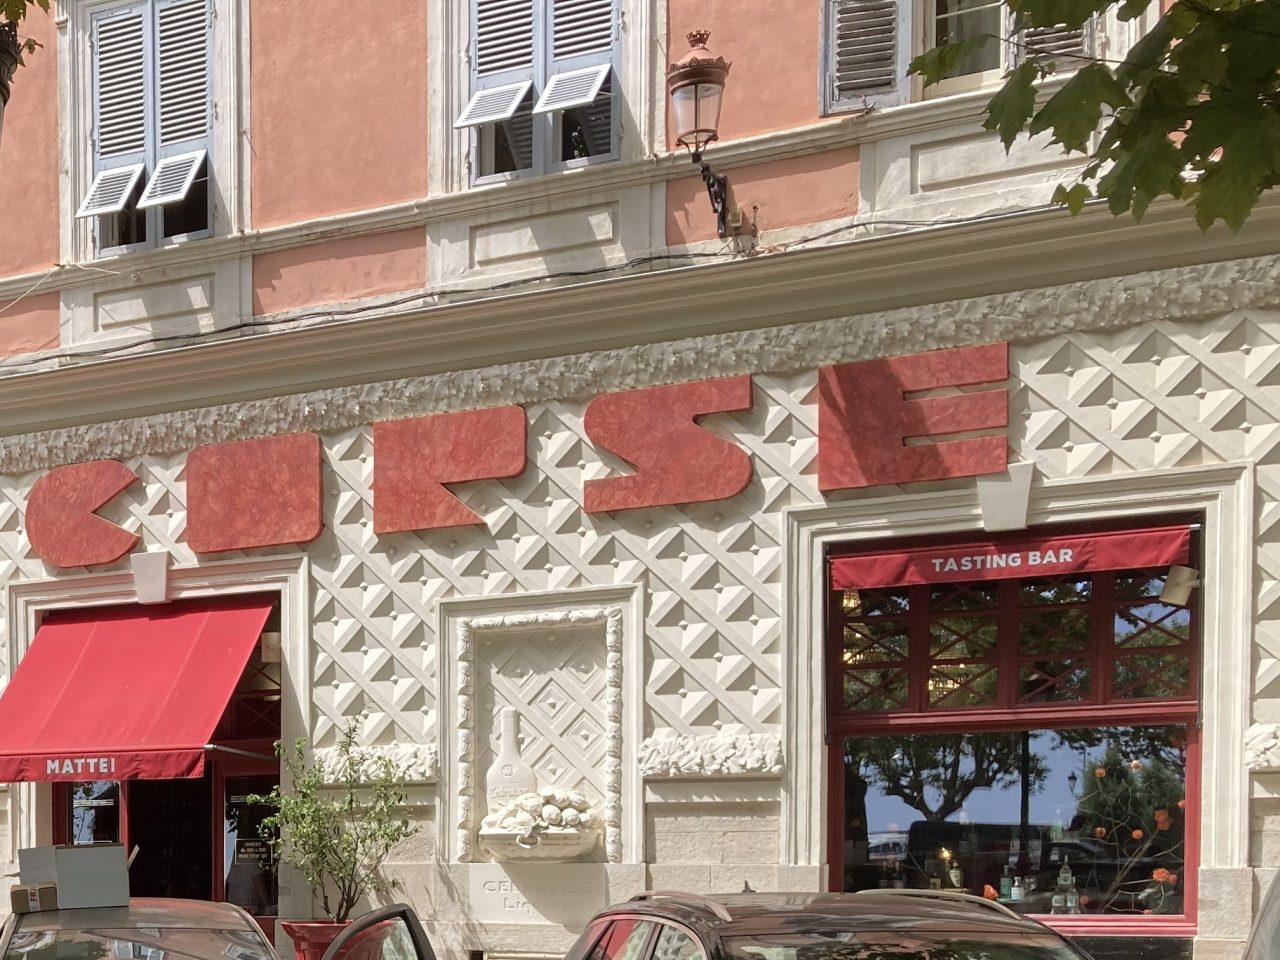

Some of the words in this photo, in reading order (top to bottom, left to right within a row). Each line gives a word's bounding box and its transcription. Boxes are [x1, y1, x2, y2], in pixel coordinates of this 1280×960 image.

[25, 340, 1010, 568] CORSE
[931, 552, 1022, 572] TASTING
[1028, 548, 1073, 566] BAR
[46, 757, 116, 774] MATTEI
